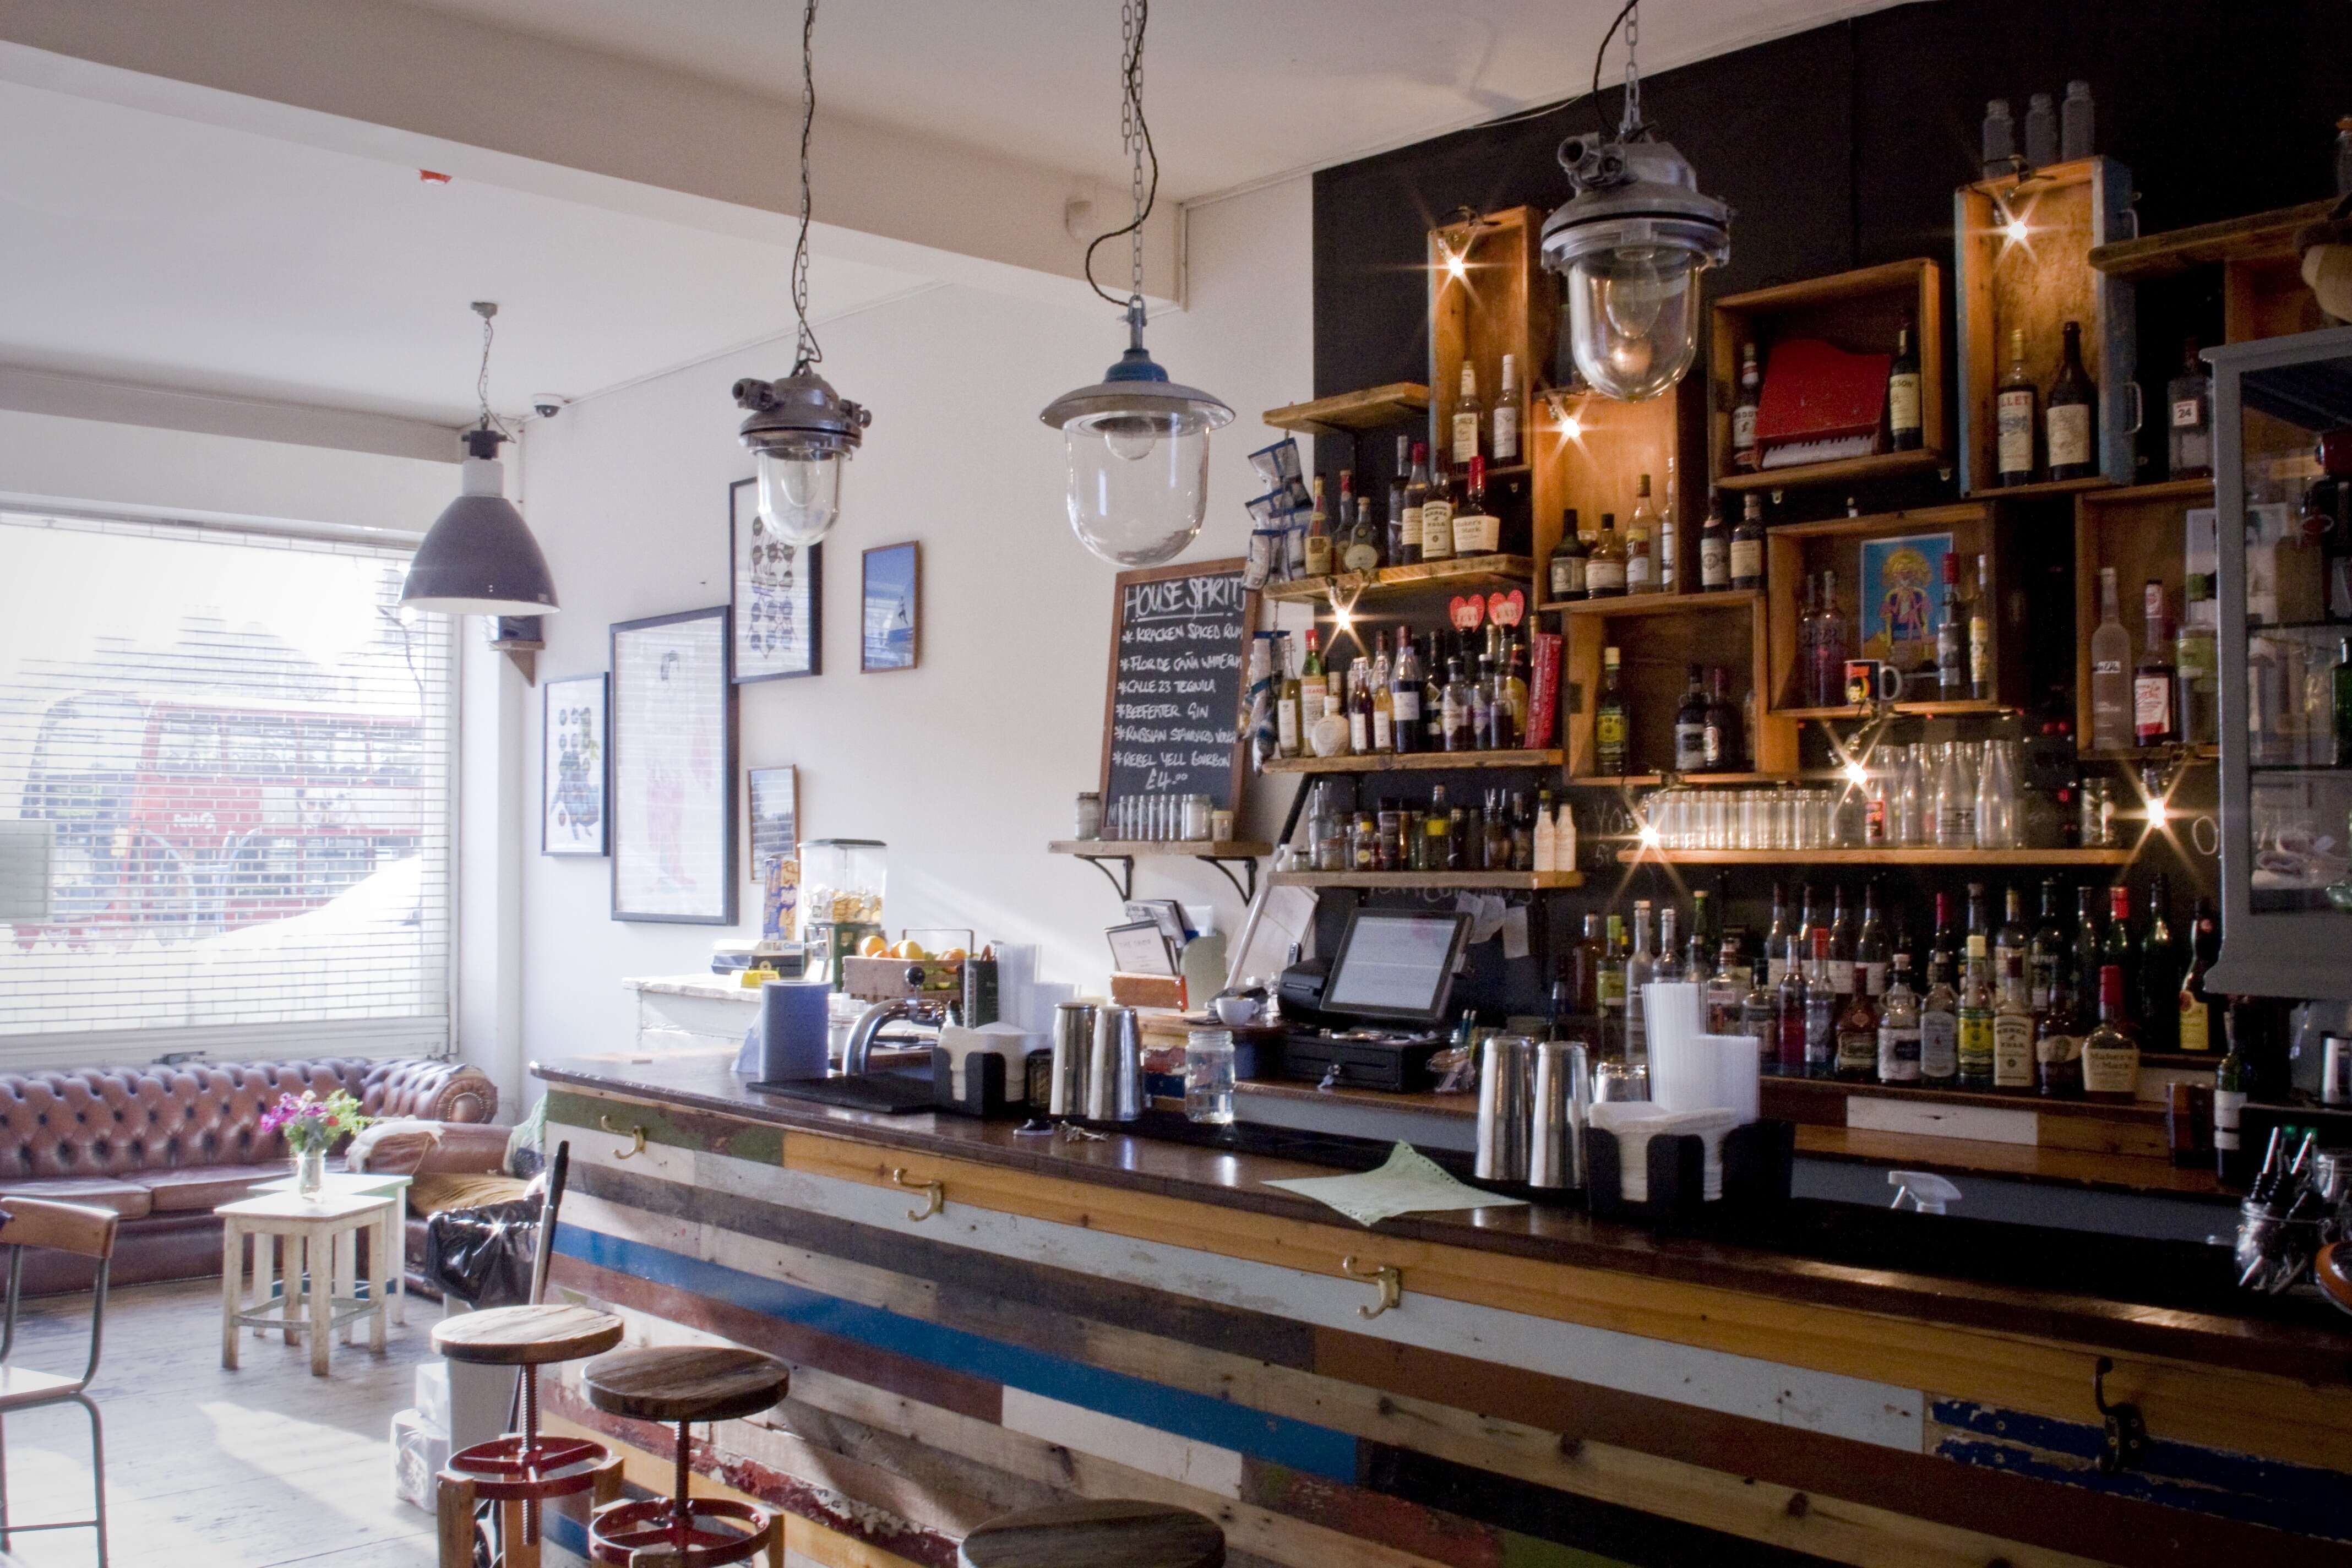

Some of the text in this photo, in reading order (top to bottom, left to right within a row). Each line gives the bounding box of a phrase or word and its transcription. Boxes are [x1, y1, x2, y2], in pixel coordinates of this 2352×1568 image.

[2177, 407, 2191, 418] 24
[1123, 581, 1184, 625] HOUSE
[1188, 623, 1221, 639] SPICED
[1224, 623, 1243, 639] RUM
[1130, 655, 1156, 671] FLOR
[1157, 658, 1171, 672] DE
[1127, 679, 1216, 693] CALLE 23 TEQUILA
[1125, 702, 1209, 720] BEEFEATER GIN
[1125, 725, 1167, 743] RUSSIAN
[1123, 750, 1231, 767] REBEL YELL BOURBON
